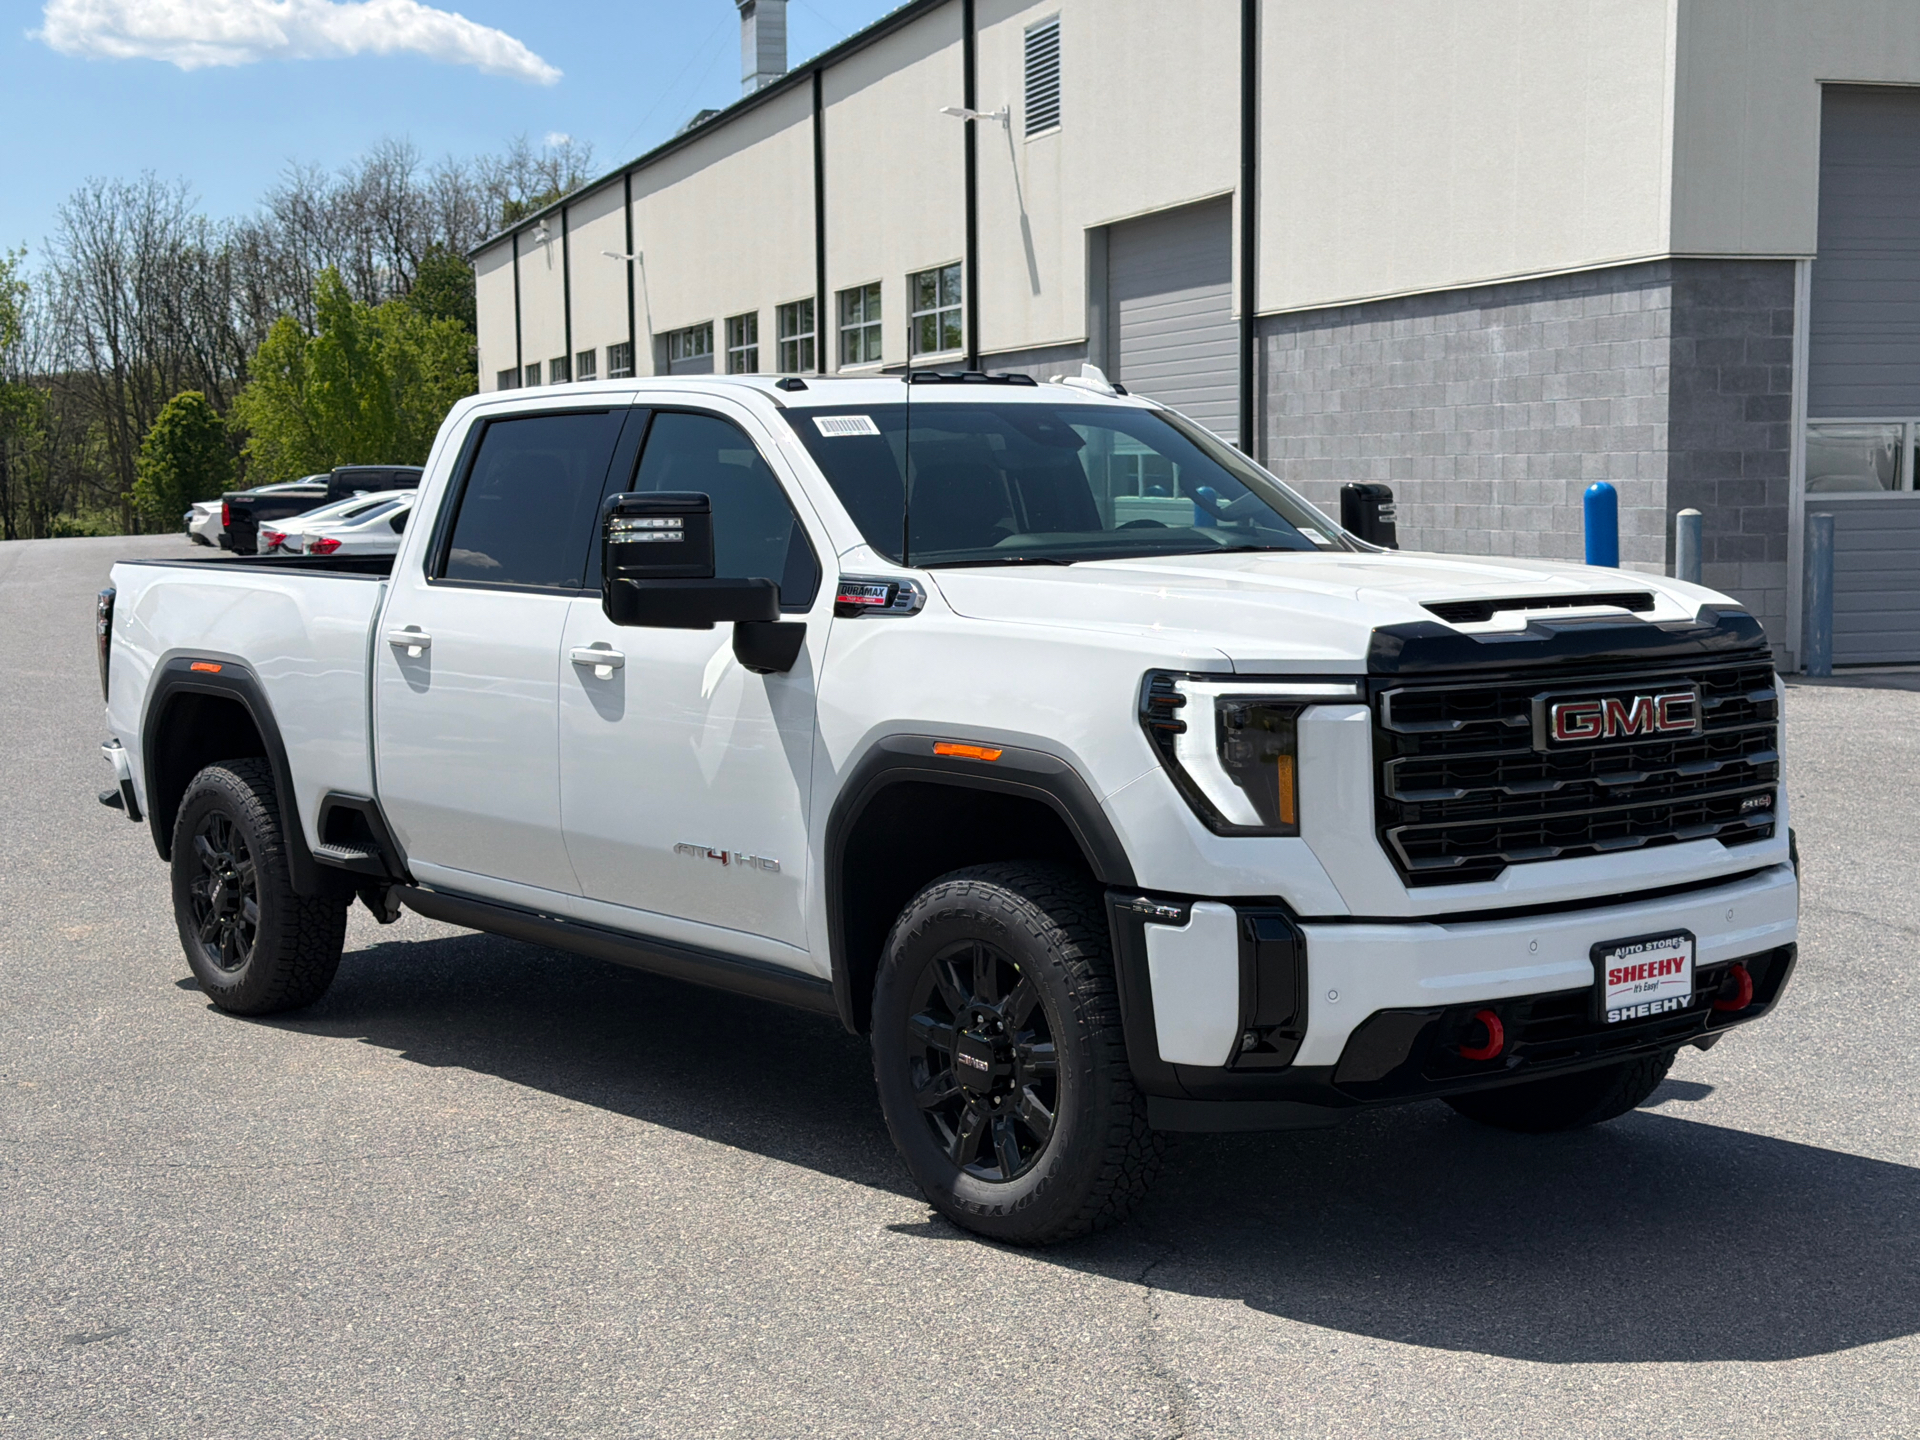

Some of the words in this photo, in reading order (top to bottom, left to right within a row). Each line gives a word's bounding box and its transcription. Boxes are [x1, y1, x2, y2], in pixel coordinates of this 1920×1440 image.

[841, 585, 885, 597] DURAMAX
[1552, 691, 1696, 741] GMC
[673, 842, 731, 867] AT4
[734, 851, 780, 872] HD
[1615, 944, 1643, 958] AUTO
[1646, 937, 1685, 951] STORES
[1608, 956, 1686, 986] SHEEHY
[1634, 984, 1643, 993] It's
[1643, 980, 1659, 993] Easy!
[1607, 995, 1692, 1023] SHEEHY
